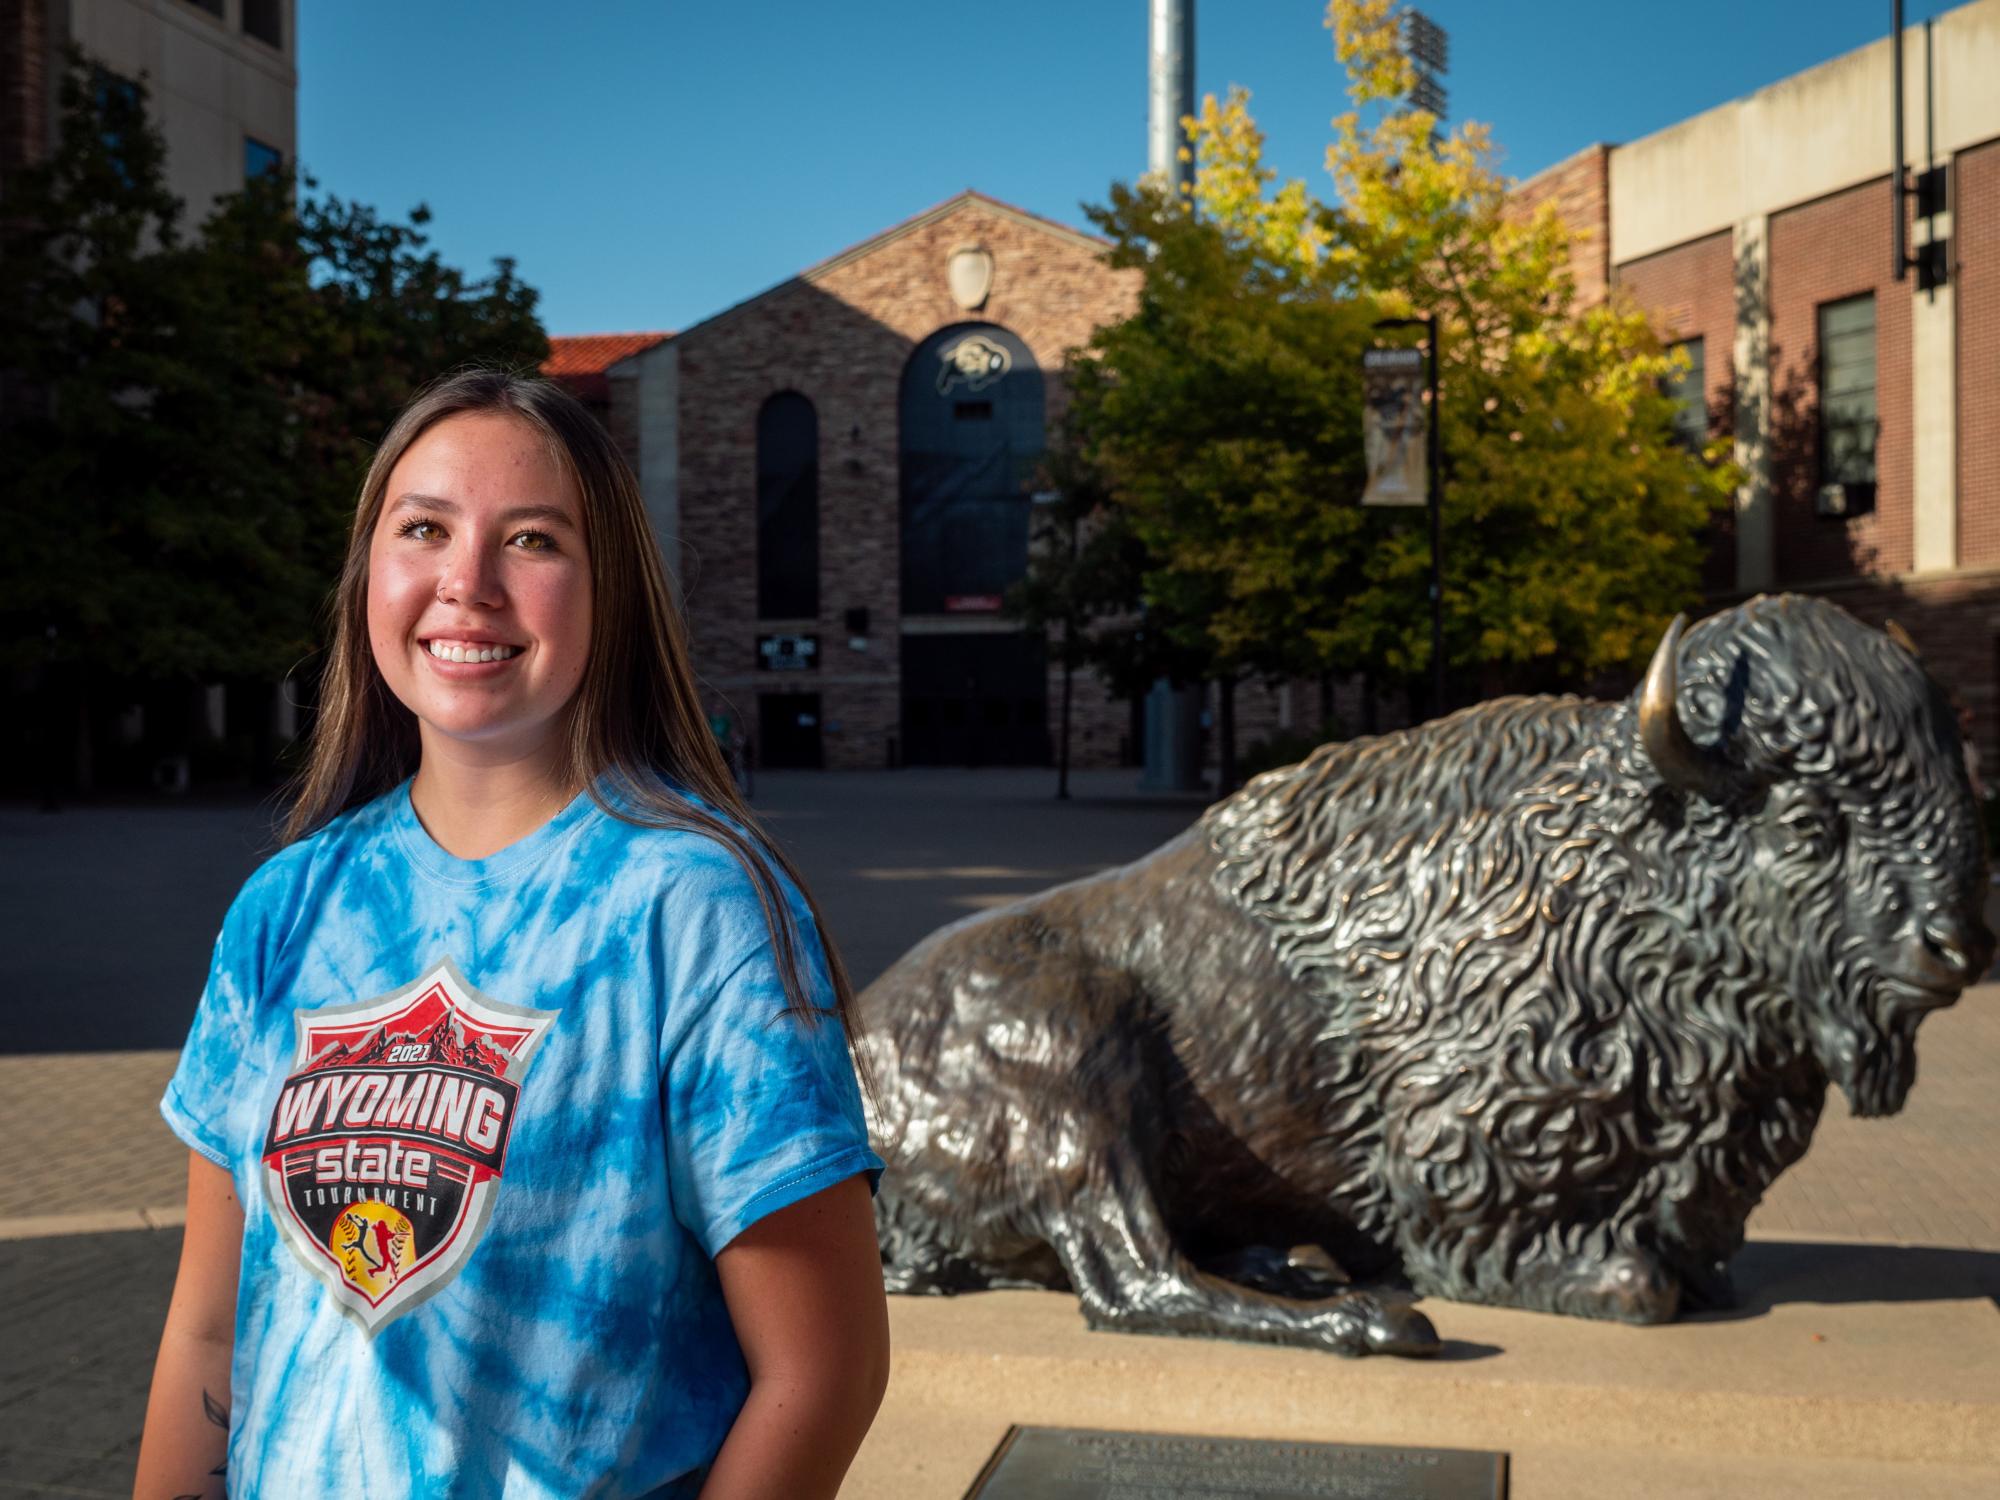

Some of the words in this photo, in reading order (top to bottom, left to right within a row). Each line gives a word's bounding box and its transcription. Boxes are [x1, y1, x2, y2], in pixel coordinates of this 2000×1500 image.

[387, 1044, 431, 1063] 2021
[274, 1073, 506, 1154] WYOMING
[316, 1140, 432, 1188] state
[303, 1186, 438, 1216] TOURNAMENT
